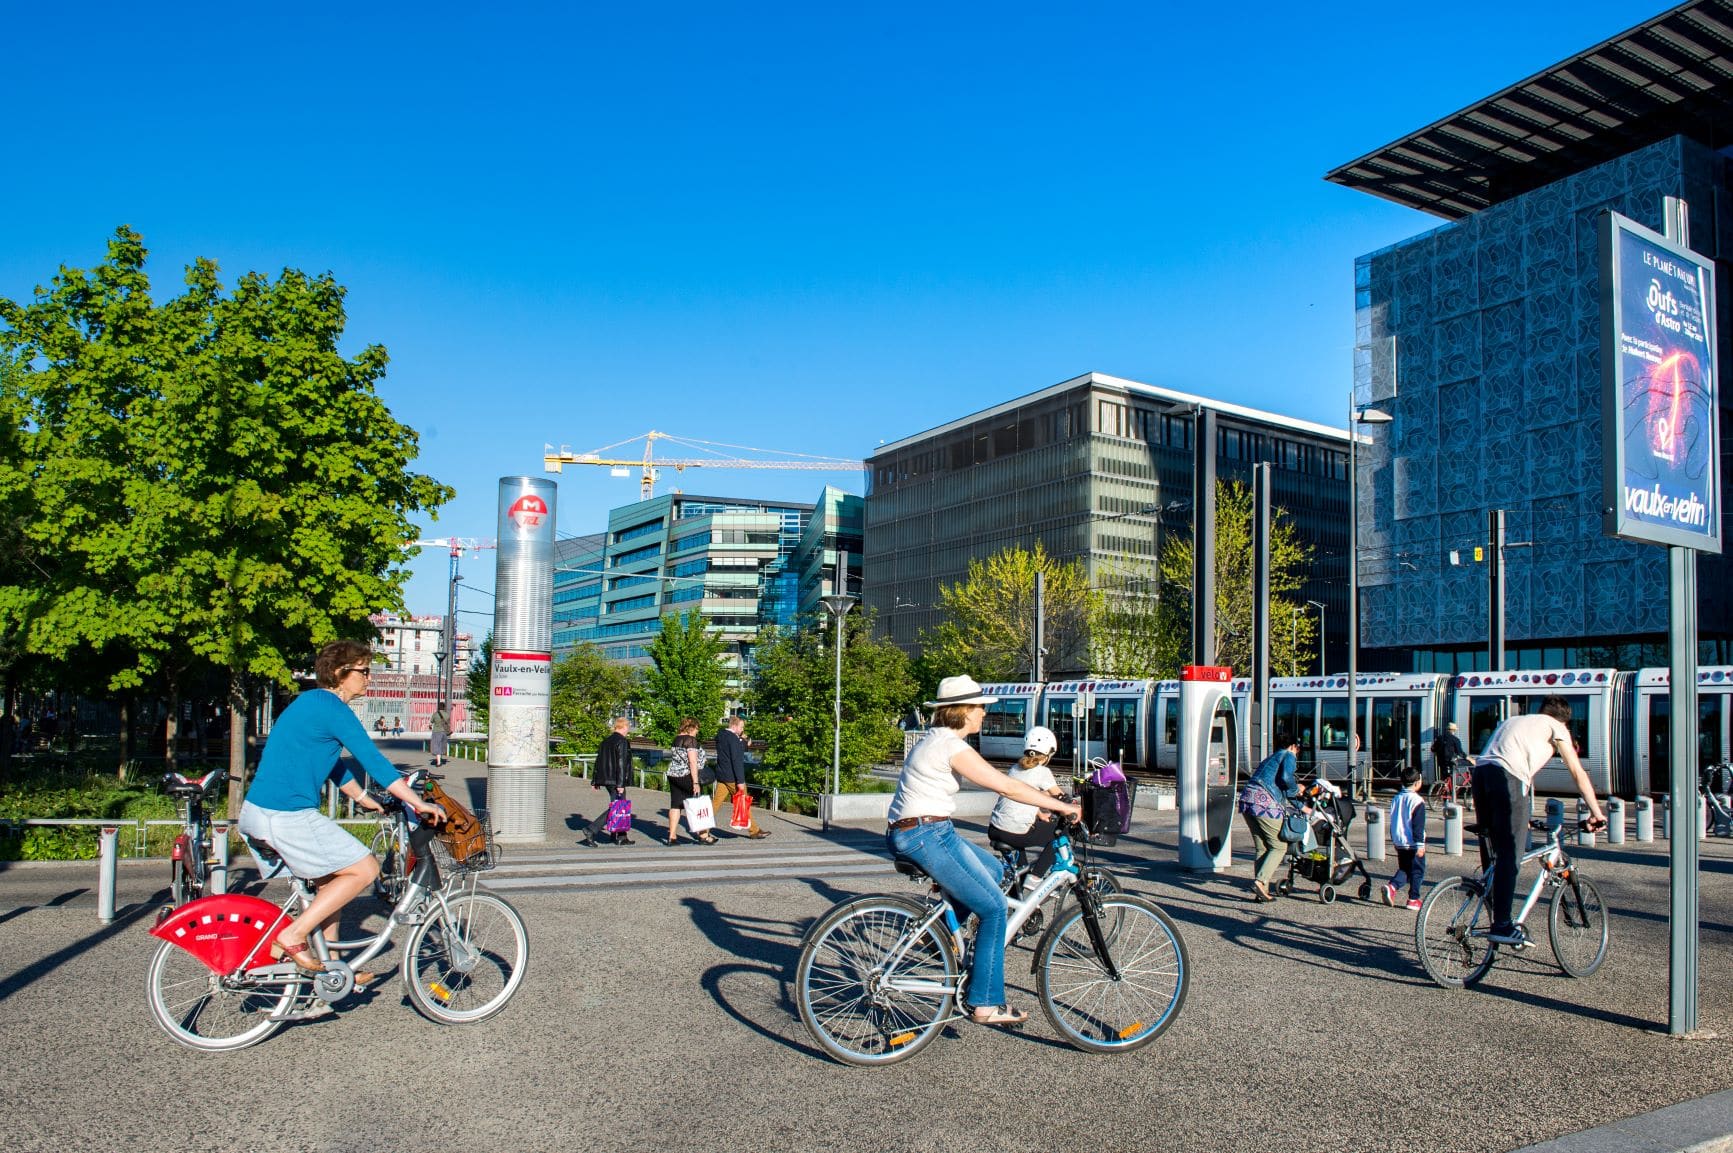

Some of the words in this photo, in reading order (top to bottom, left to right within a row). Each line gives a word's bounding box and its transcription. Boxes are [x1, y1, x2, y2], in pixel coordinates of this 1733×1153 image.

[1643, 250, 1652, 266] LE
[522, 499, 540, 511] M
[1624, 483, 1667, 518] vaulx
[1671, 491, 1705, 527] velin
